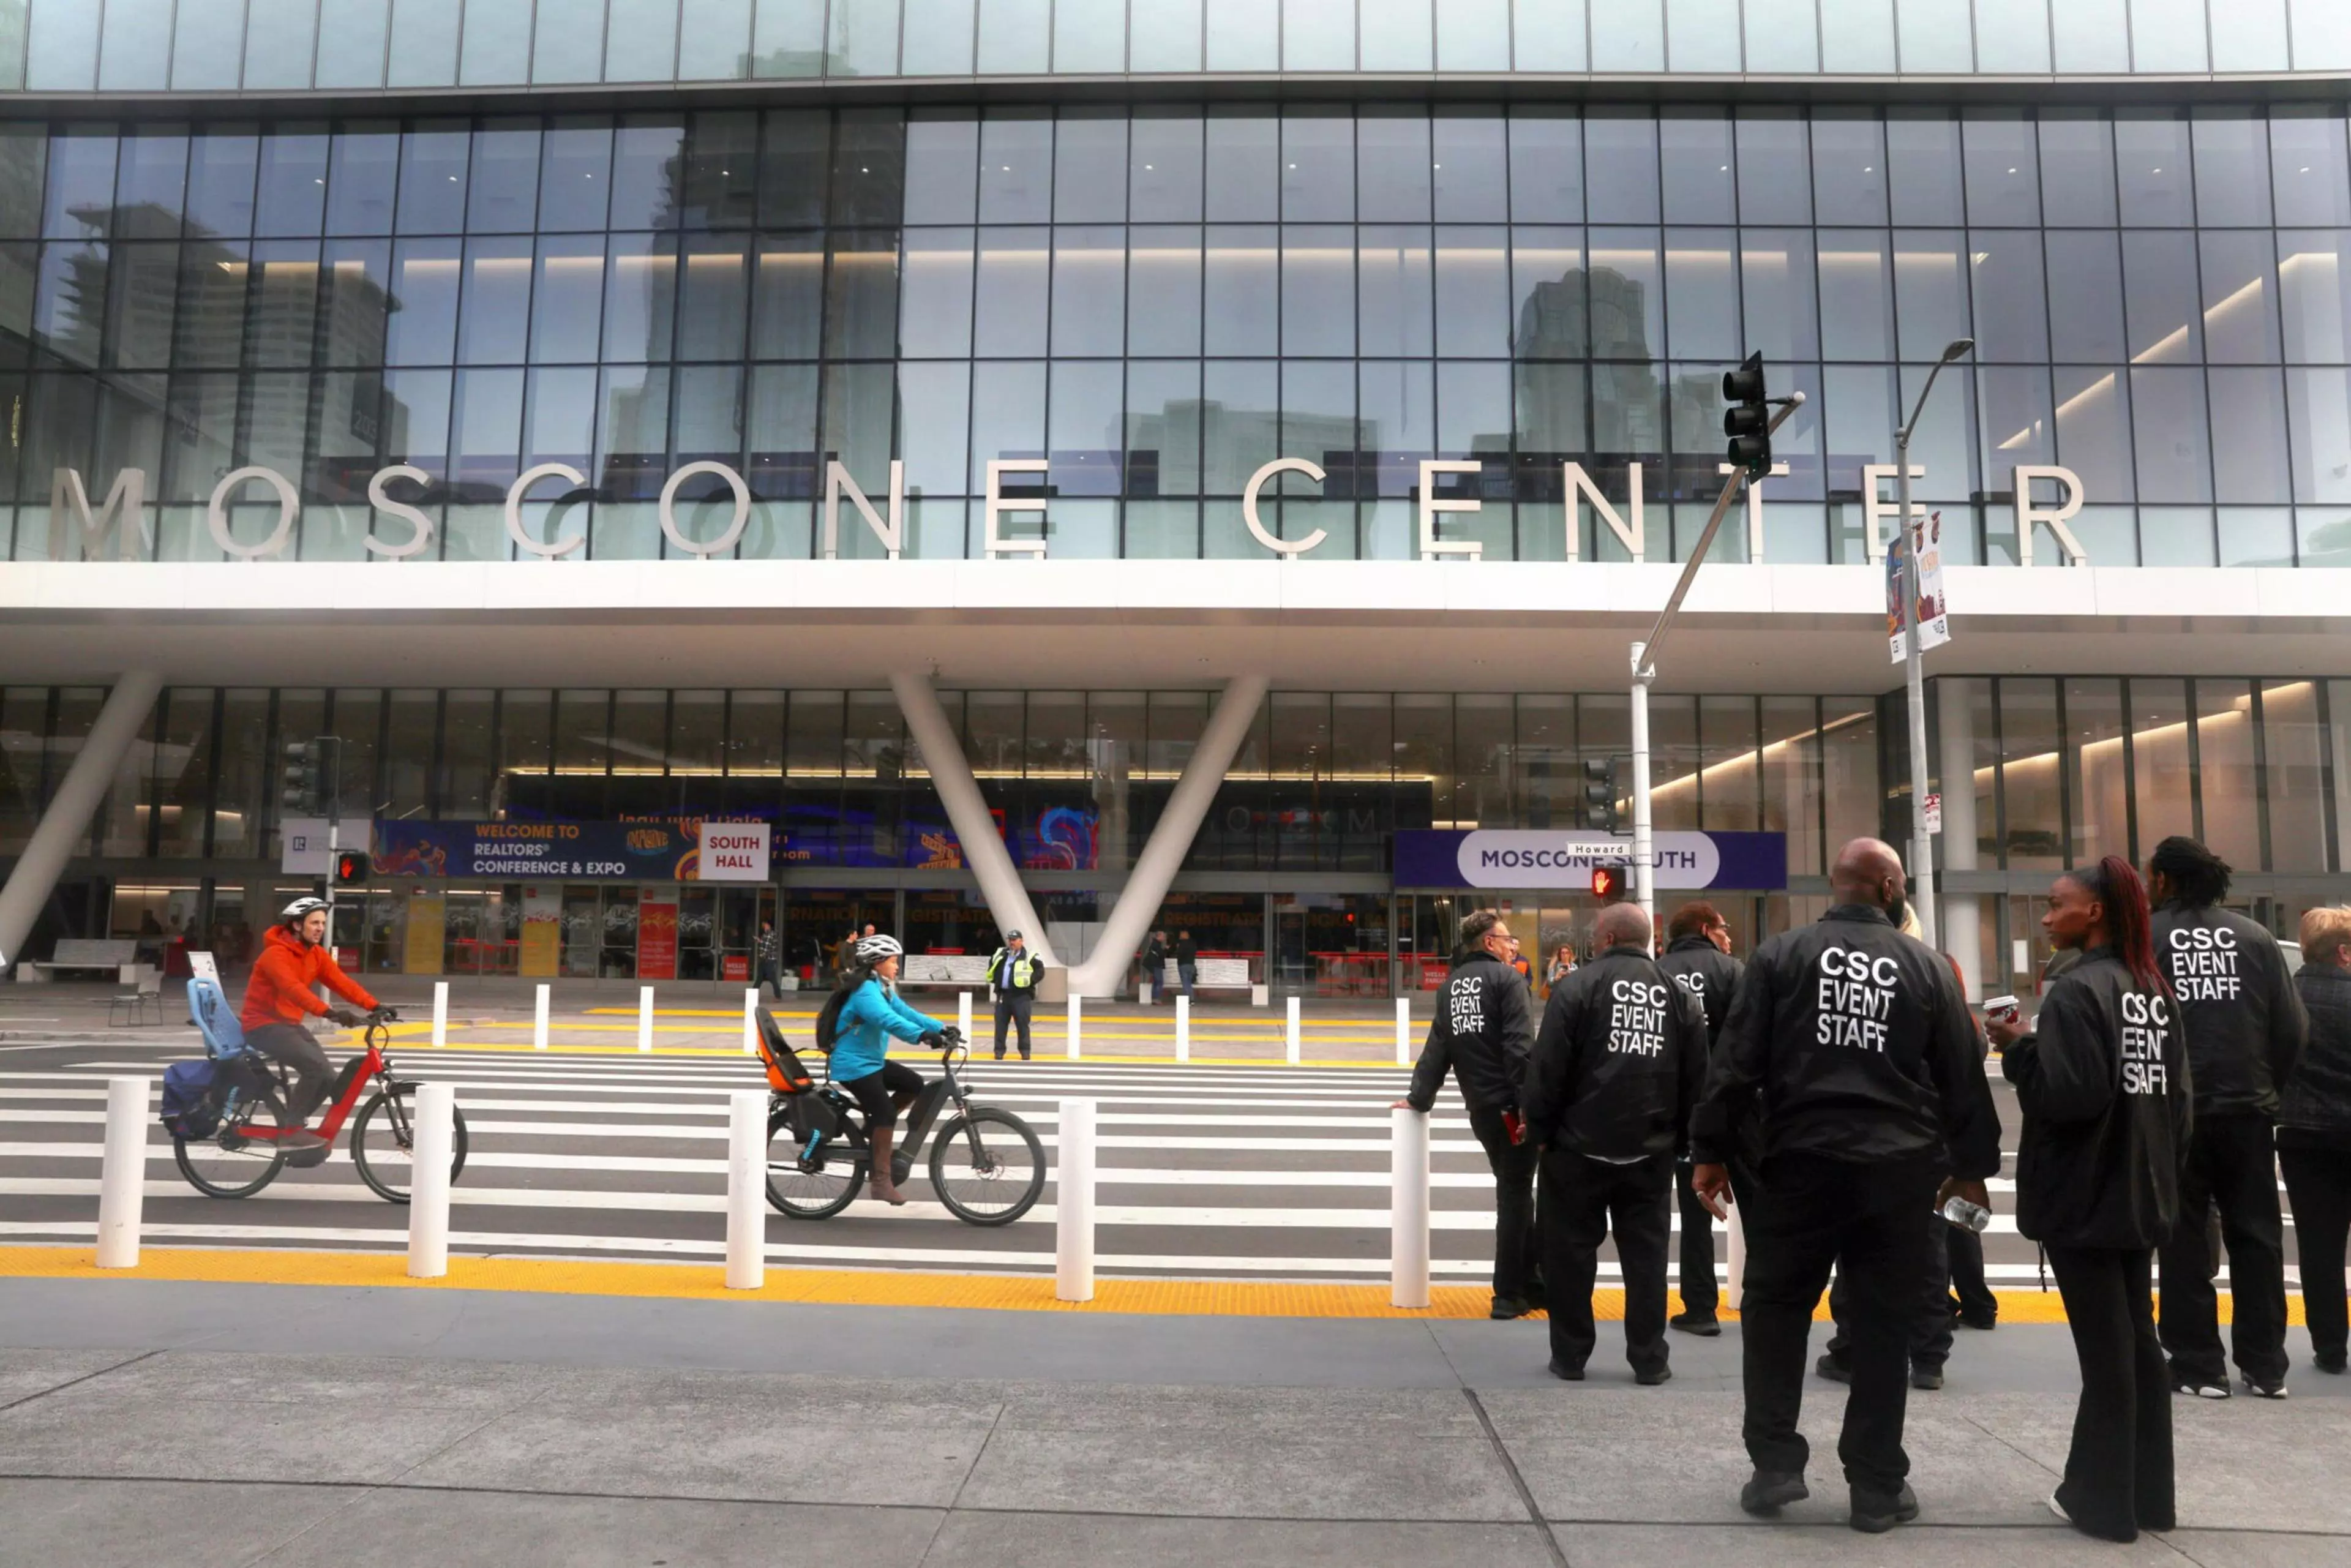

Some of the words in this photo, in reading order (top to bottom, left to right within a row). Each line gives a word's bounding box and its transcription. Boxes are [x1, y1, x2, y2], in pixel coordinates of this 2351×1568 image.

[48, 459, 1048, 558] MOSCONE
[1243, 458, 2086, 562] CENTER
[475, 824, 554, 838] WELCOME
[558, 825, 580, 839] TO
[709, 836, 760, 850] SOUTH
[1482, 850, 1605, 868] MOSCONE
[1612, 852, 1695, 869] UTH
[1575, 844, 1623, 853] Howard
[473, 860, 568, 874] CONFERENCE
[571, 861, 582, 874] &
[586, 861, 626, 875] EXPO
[716, 855, 753, 868] HALL
[2169, 927, 2237, 950] CSC
[1820, 947, 1899, 986] CSC
[2172, 951, 2238, 976] EVENT
[1451, 977, 1482, 996] CSC
[1674, 972, 1704, 991] SC
[2175, 977, 2241, 1001] STAFF
[1612, 980, 1667, 1008] CSC
[1818, 978, 1895, 1020] EVENT
[1450, 996, 1481, 1016] EVENT
[2121, 991, 2169, 1026] CSC
[1452, 1015, 1485, 1035] STAFF
[1611, 1004, 1666, 1033] EVENT
[1608, 1029, 1665, 1057] STAFF
[1817, 1013, 1888, 1052] STAFF
